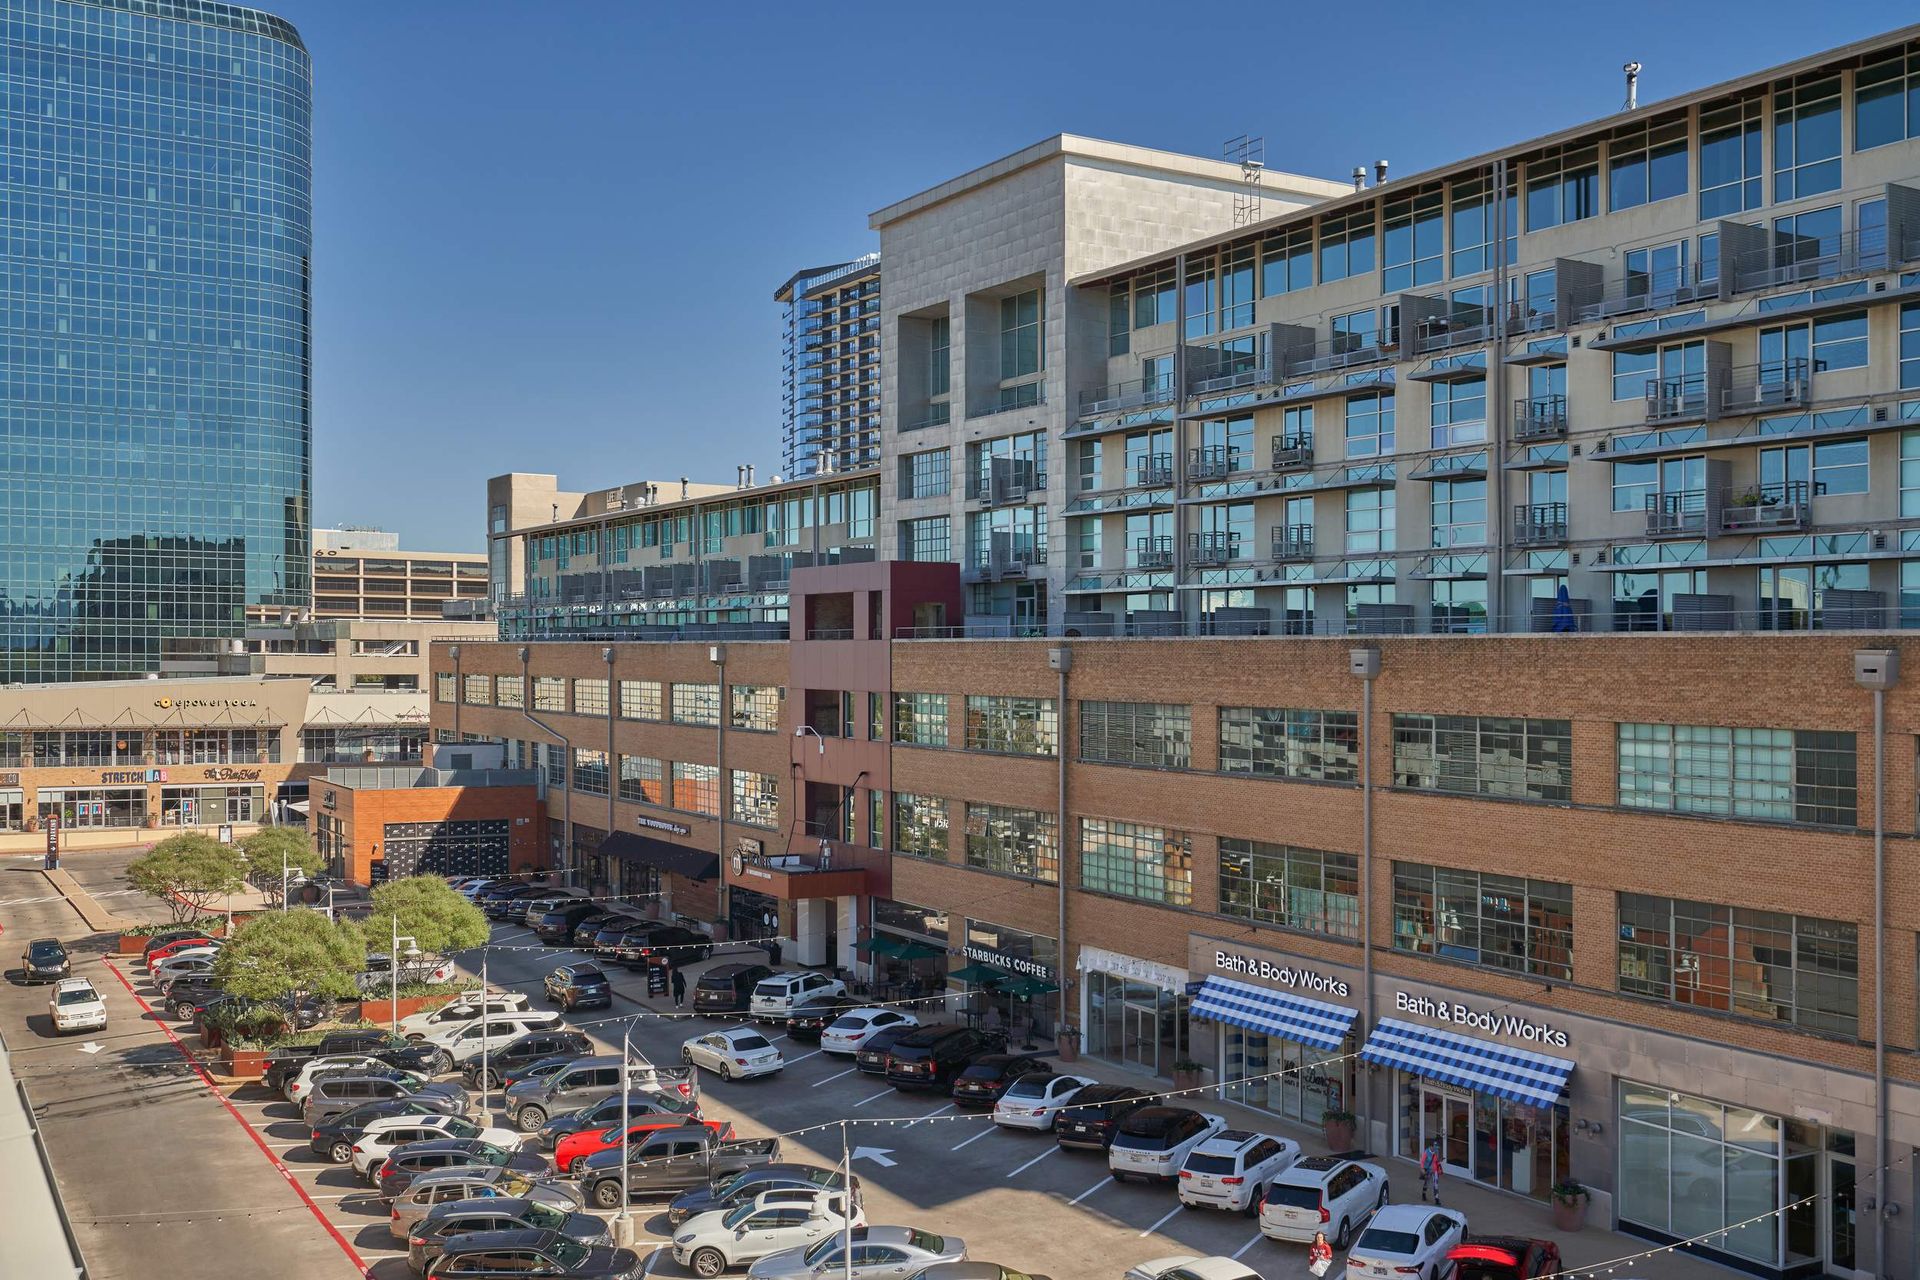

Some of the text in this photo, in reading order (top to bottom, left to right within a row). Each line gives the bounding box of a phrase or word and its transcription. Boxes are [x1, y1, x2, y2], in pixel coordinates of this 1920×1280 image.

[962, 946, 1047, 978] STARBUCKS COFFEE
[1216, 951, 1349, 997] Bath & Body Works
[1396, 992, 1568, 1048] Bath & Body Works
